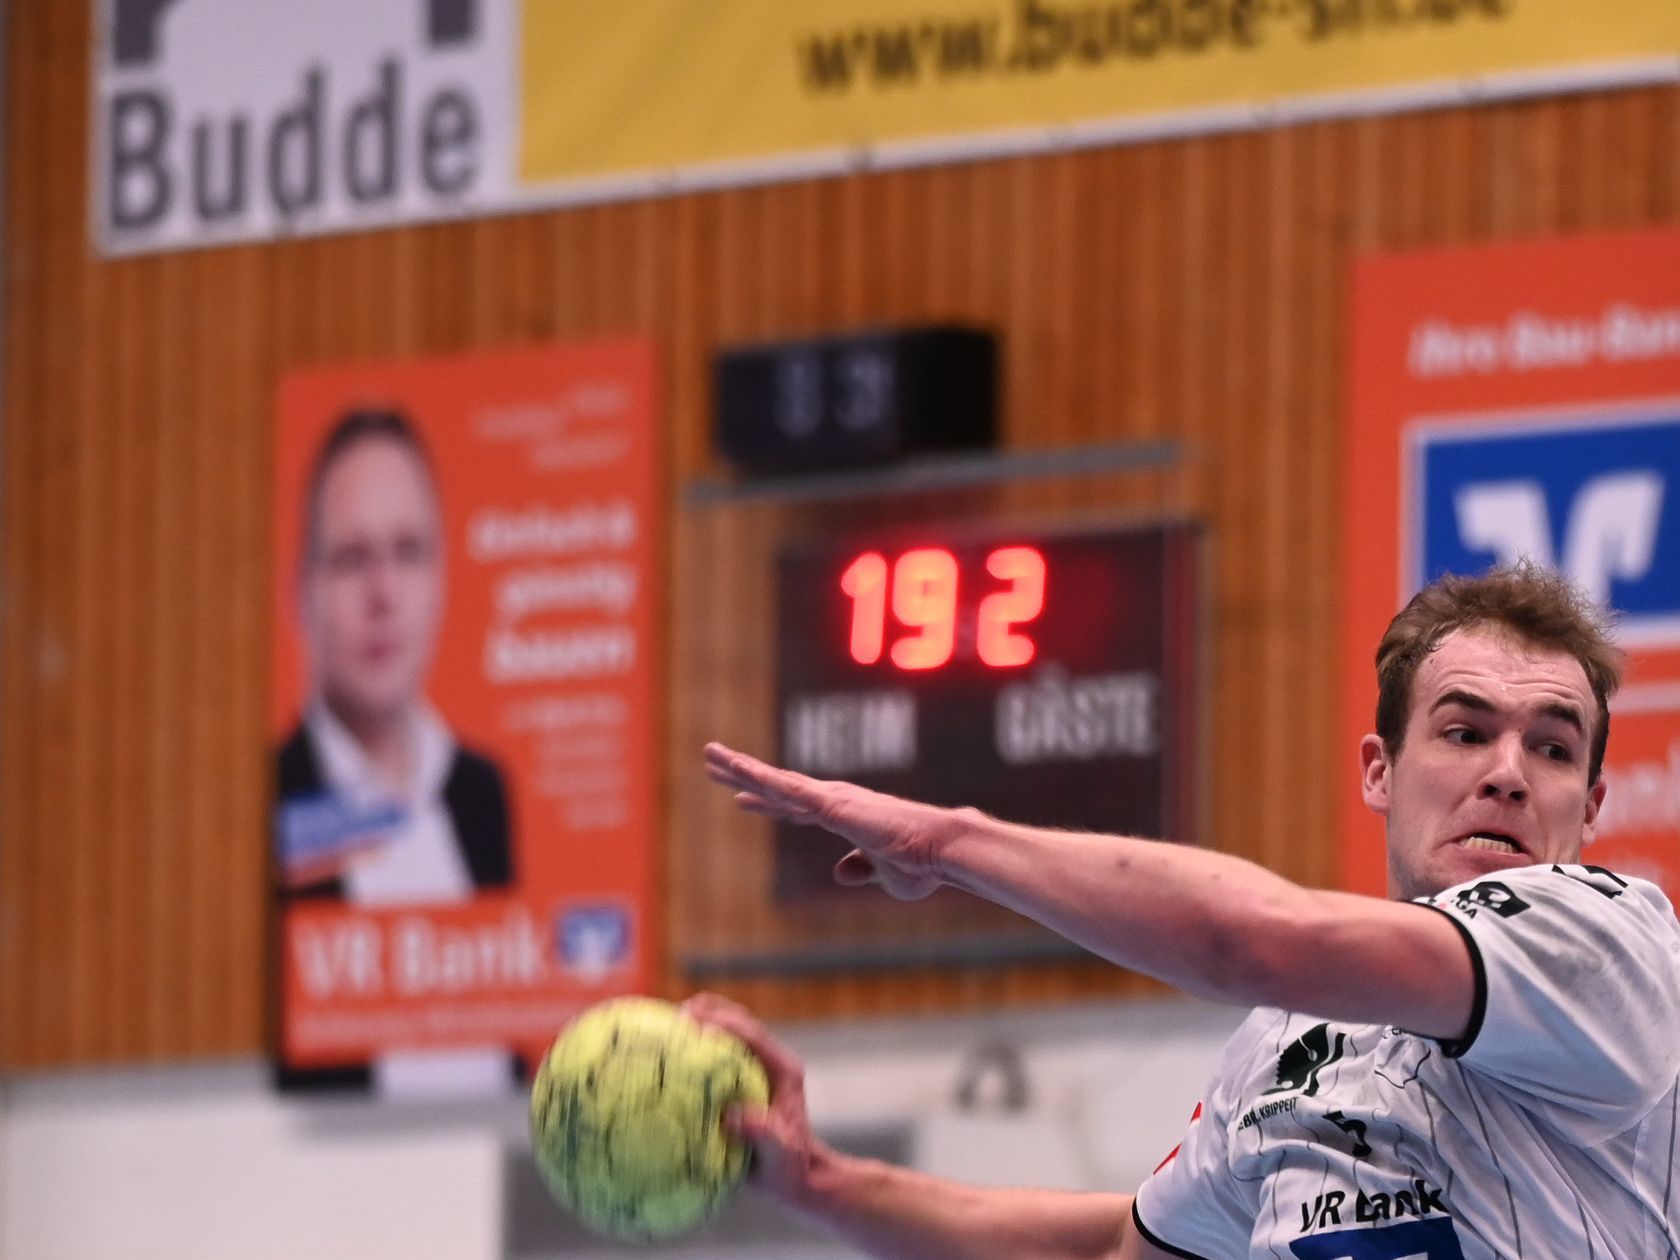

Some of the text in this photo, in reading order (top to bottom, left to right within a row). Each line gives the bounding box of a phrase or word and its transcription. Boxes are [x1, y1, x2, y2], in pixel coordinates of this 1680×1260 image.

[108, 57, 482, 232] Budde
[785, 663, 1157, 776] HEIM GÄSTE
[293, 904, 546, 1000] VR Bank
[1300, 1190, 1346, 1233] VR
